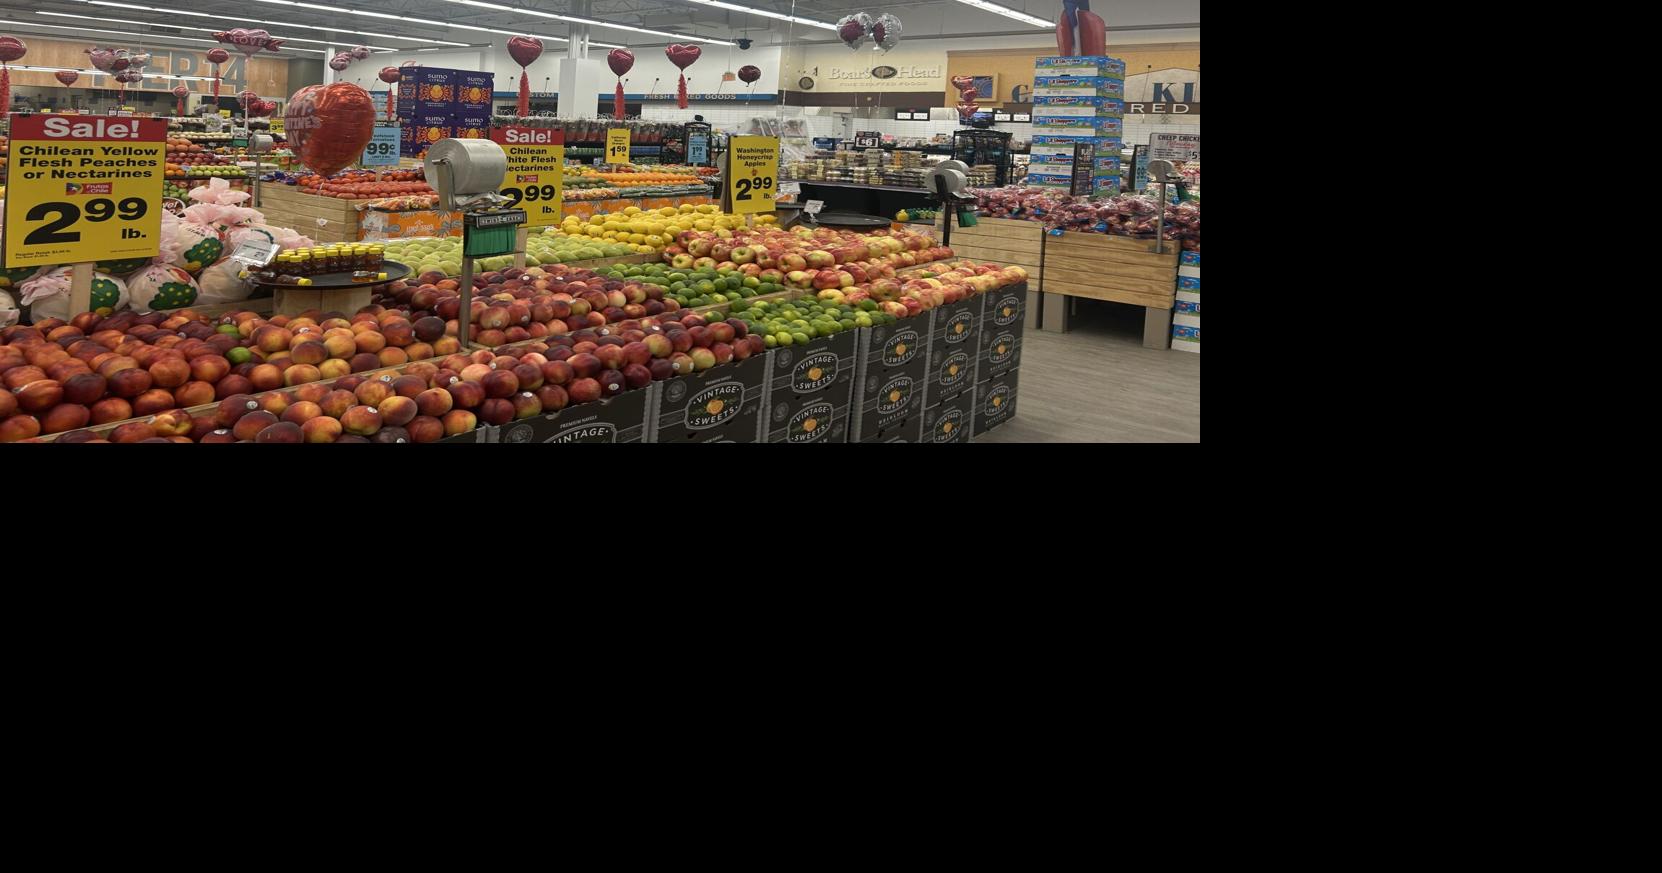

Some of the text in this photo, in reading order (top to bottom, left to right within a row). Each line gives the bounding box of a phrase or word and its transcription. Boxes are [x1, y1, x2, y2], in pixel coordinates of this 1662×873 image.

[897, 65, 942, 78] Head
[1131, 103, 1190, 113] RED
[44, 117, 140, 139] Sale!
[505, 129, 551, 143] Sale!
[19, 145, 158, 156] Chilean Yellow
[510, 147, 547, 155] Chilean
[19, 157, 157, 167] Flesh Peaches
[506, 164, 554, 172] ectarines
[23, 169, 152, 179] or Nectarines
[542, 206, 555, 214] lb.
[121, 228, 147, 239] lb.
[890, 334, 914, 346] VINTAGE
[800, 356, 832, 370] VINTAGE
[889, 350, 913, 363] SWEETS
[799, 374, 831, 389] SWEETS
[884, 380, 908, 393] VINTAGE
[696, 385, 739, 403] VINTAGE
[882, 396, 908, 411] SWEETS
[694, 407, 735, 425] SWEETS
[796, 406, 828, 423] VINTAGE
[559, 419, 582, 429] PREMIUM
[794, 424, 825, 441] SWEETS
